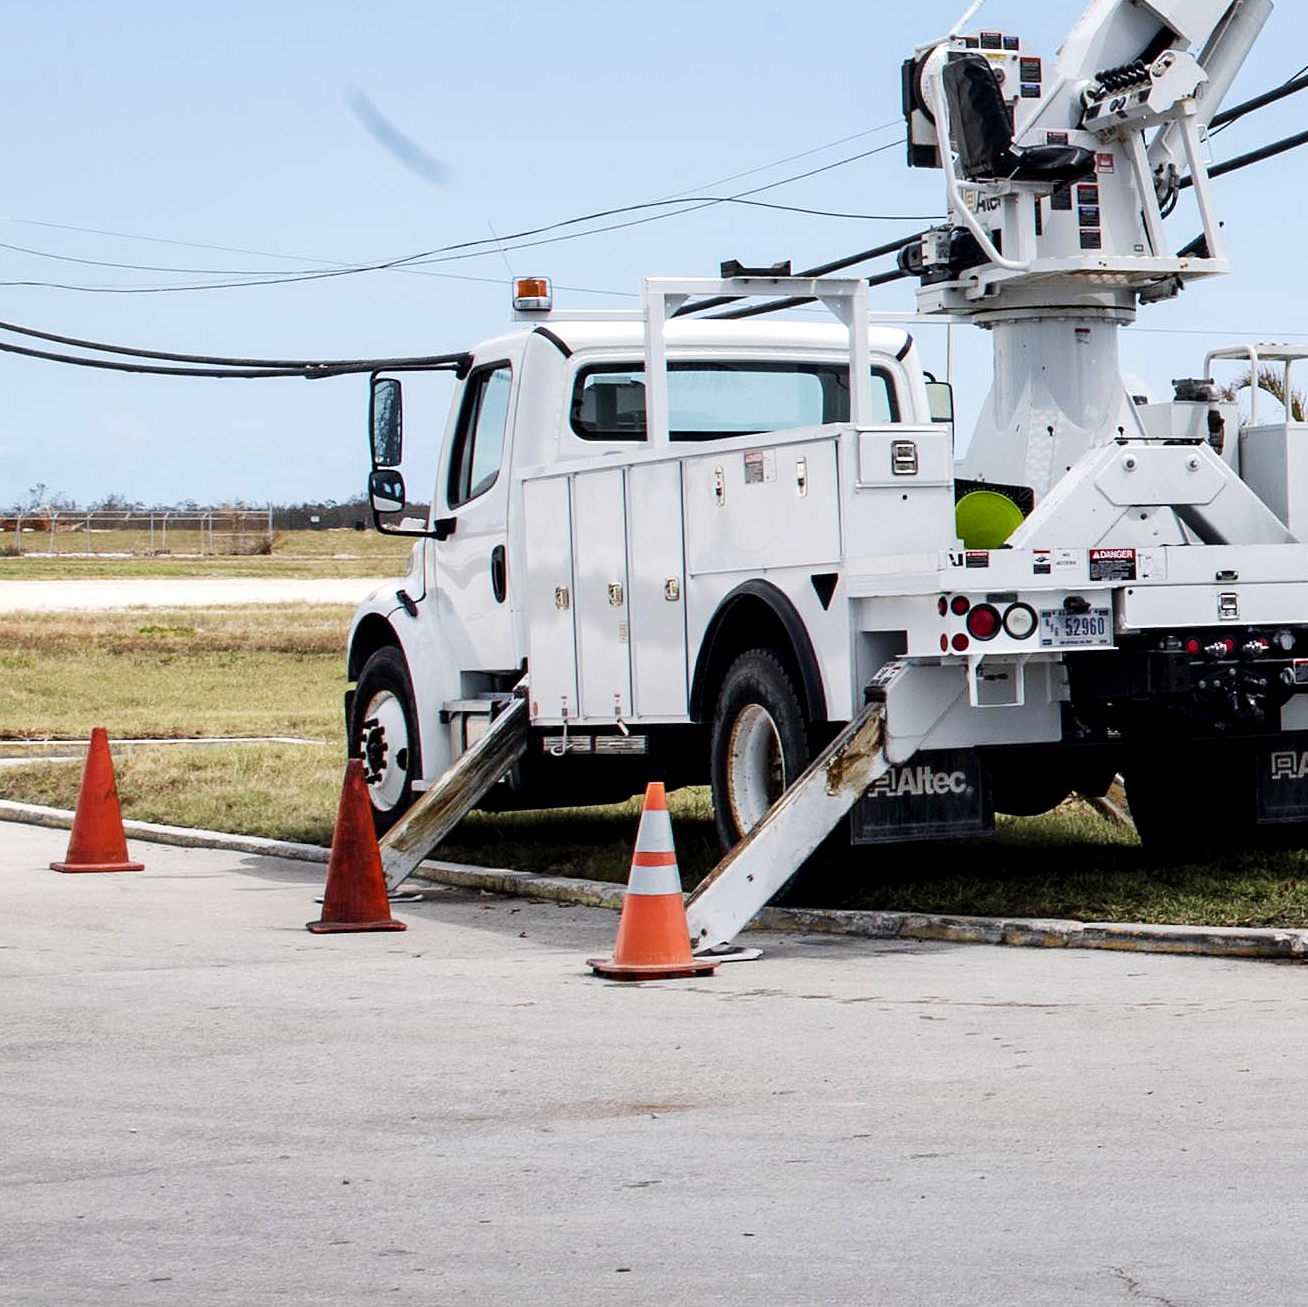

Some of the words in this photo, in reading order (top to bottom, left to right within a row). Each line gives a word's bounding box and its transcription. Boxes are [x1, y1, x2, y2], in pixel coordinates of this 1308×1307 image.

[1101, 550, 1133, 559] DANGER
[1065, 617, 1105, 636] 52960
[896, 765, 966, 796] Altec
